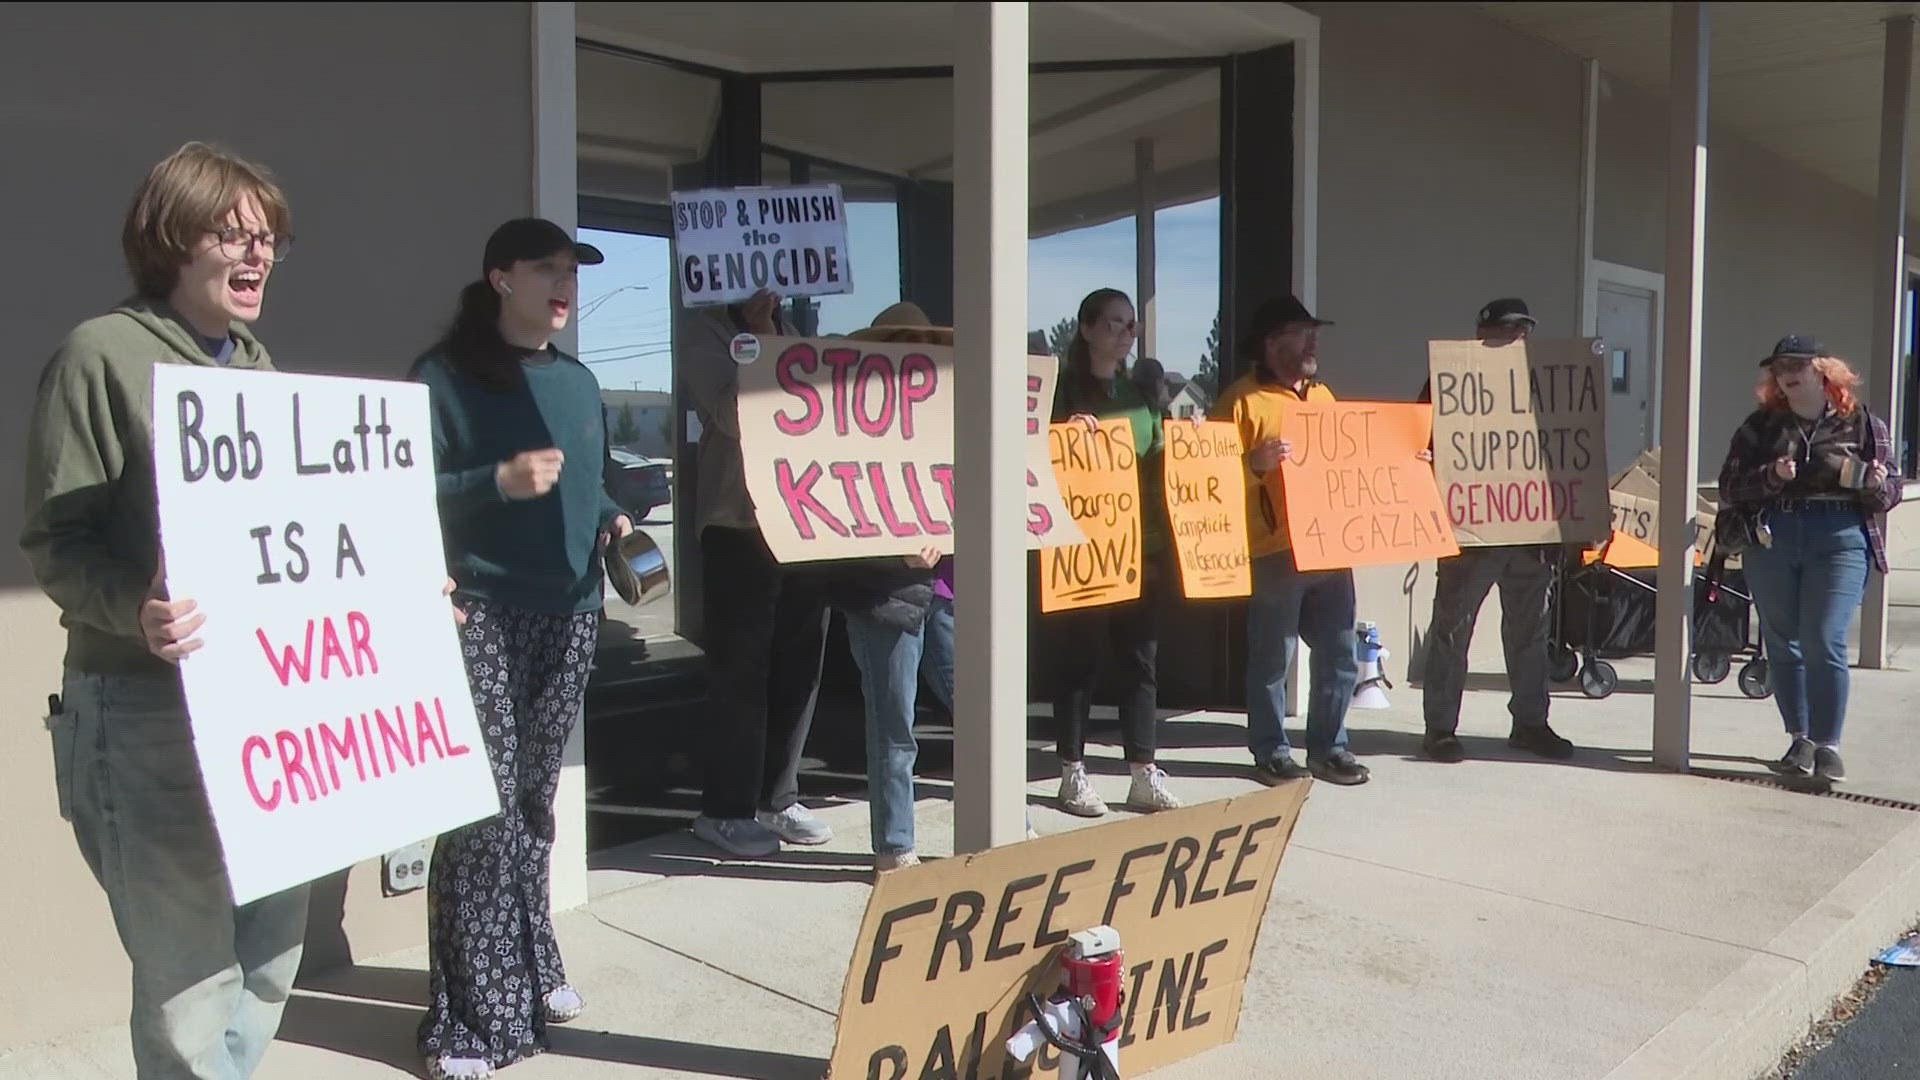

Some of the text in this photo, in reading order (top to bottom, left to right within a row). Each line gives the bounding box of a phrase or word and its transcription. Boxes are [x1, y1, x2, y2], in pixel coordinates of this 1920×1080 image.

[677, 196, 836, 231] STOP & PUNISH
[742, 229, 781, 246] the
[684, 246, 839, 293] GENOCIDE
[773, 342, 938, 440] STOP
[1510, 365, 1598, 415] LATTA
[177, 390, 414, 483] Bob Latta
[1289, 411, 1377, 467] JUST
[1452, 427, 1591, 472] SUPPORTS
[1063, 485, 1132, 527] bargo
[1207, 476, 1223, 504] R
[1326, 466, 1408, 510] PEACE
[1447, 479, 1584, 527] GENOCIDE
[249, 521, 366, 585] IS A
[1051, 517, 1137, 590] NOW!
[1305, 510, 1446, 557] 4 GAZA!
[256, 611, 379, 686] WAR
[241, 697, 470, 811] CRIMINAL
[861, 816, 1282, 1005] FREE FREE
